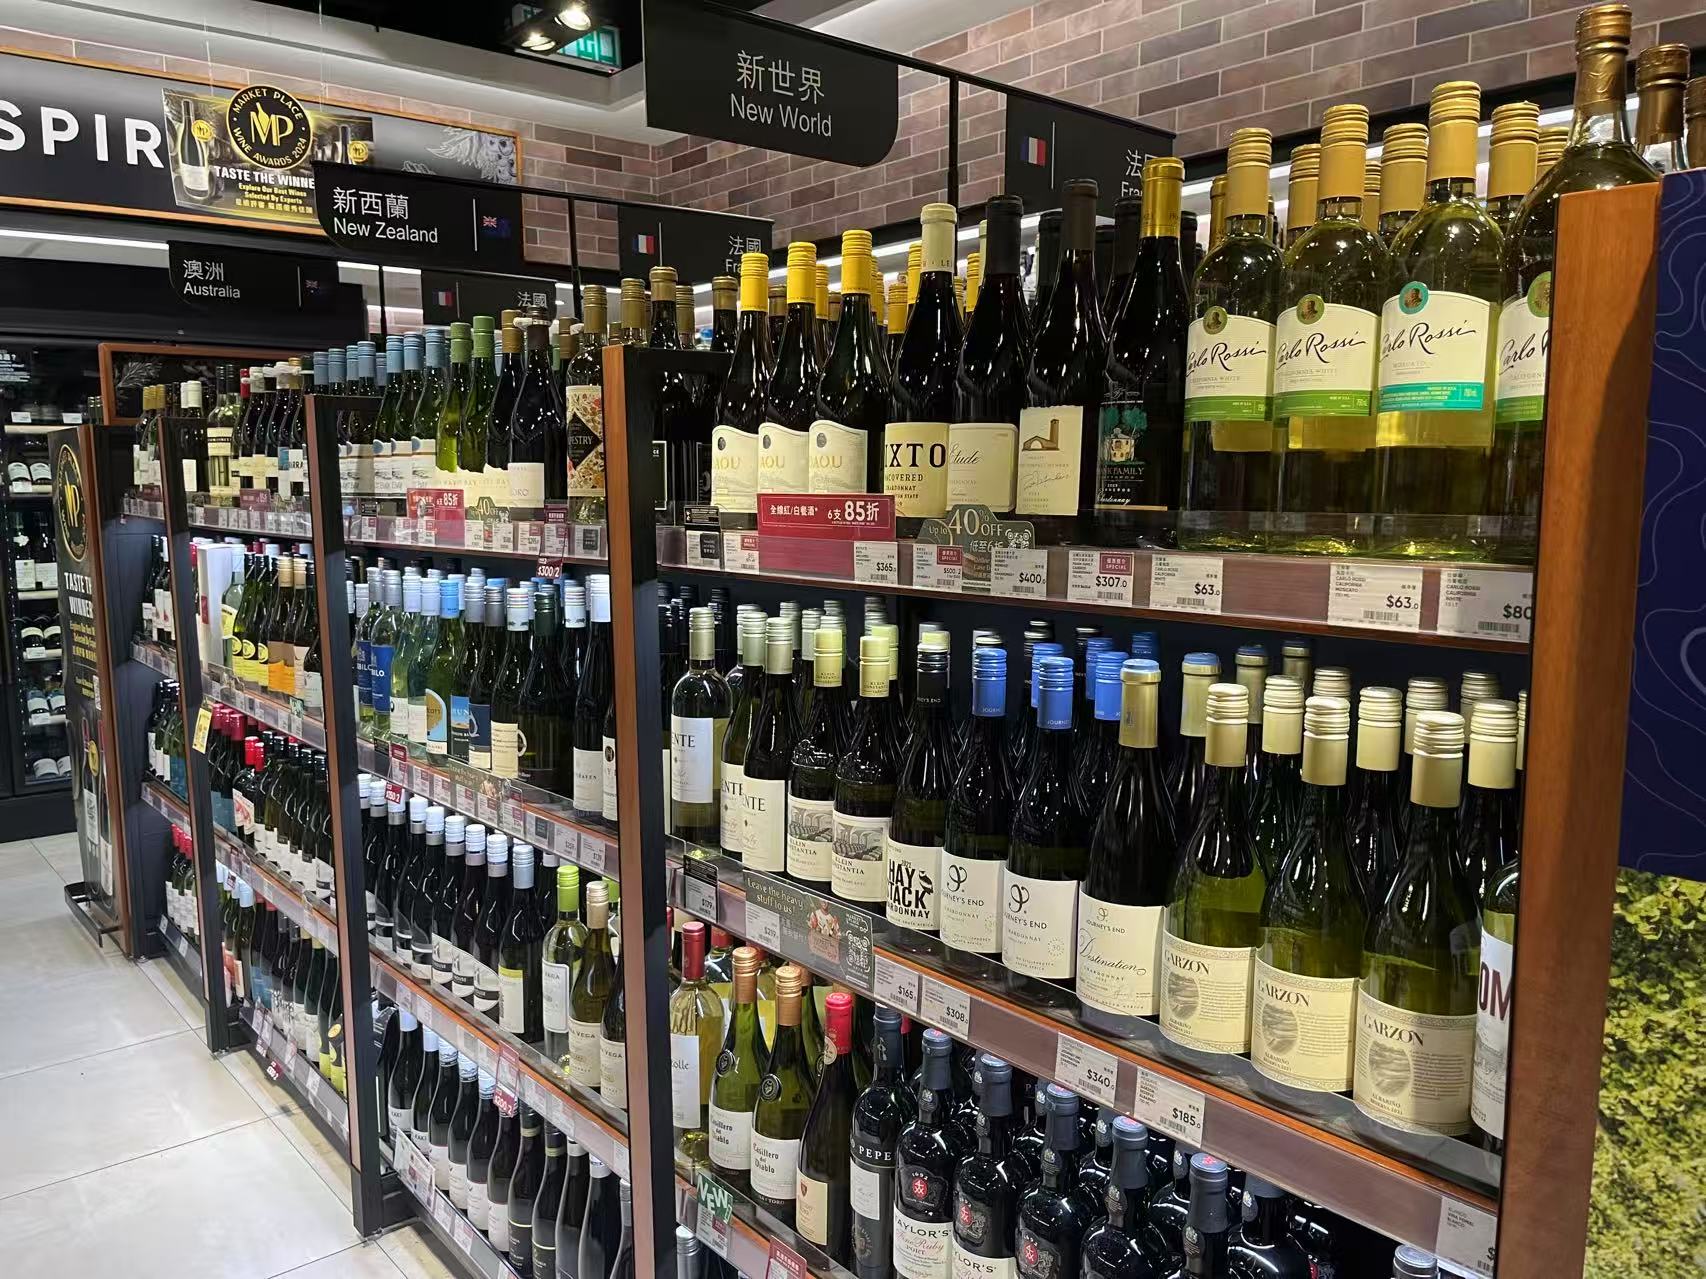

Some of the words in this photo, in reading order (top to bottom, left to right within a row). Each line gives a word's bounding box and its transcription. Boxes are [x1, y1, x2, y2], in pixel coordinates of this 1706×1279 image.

[736, 49, 825, 105] 新世界
[232, 88, 268, 114] MARKET
[273, 91, 304, 120] PLACE
[730, 92, 774, 125] New
[778, 103, 832, 137] World
[232, 127, 253, 154] WINE
[253, 152, 293, 167] AWARDS
[291, 137, 308, 159] 2024
[214, 165, 251, 182] TASTE
[252, 170, 275, 185] THE
[277, 174, 315, 190] WINNE
[332, 187, 409, 220] 新西蘭
[333, 217, 370, 238] New
[375, 222, 438, 244] Zealand
[727, 234, 762, 255] 法國
[183, 259, 225, 281] 澳洲
[183, 281, 241, 299] Australia
[1305, 330, 1367, 363] Rossi
[1408, 320, 1476, 355] Rossi
[1210, 340, 1267, 371] Rossi
[1498, 333, 1536, 376] Carlo
[844, 500, 880, 522] 85折
[980, 523, 1004, 537] OFF
[63, 571, 85, 594] TASTE
[1095, 575, 1128, 588] $307.0
[1193, 582, 1221, 596] $63.0
[1386, 595, 1419, 610] $63.0
[889, 858, 916, 889] HAY
[747, 876, 769, 893] Leave
[769, 885, 781, 899] the
[781, 888, 805, 911] heavy
[757, 893, 774, 909] stuff
[774, 899, 783, 910] to
[967, 898, 985, 907] END
[1029, 921, 1048, 930] END
[1112, 926, 1126, 934] END
[1079, 927, 1147, 976] Destination
[1172, 1107, 1201, 1129] $185.0
[752, 1142, 779, 1160] Casillero
[858, 1145, 892, 1161] PEPE
